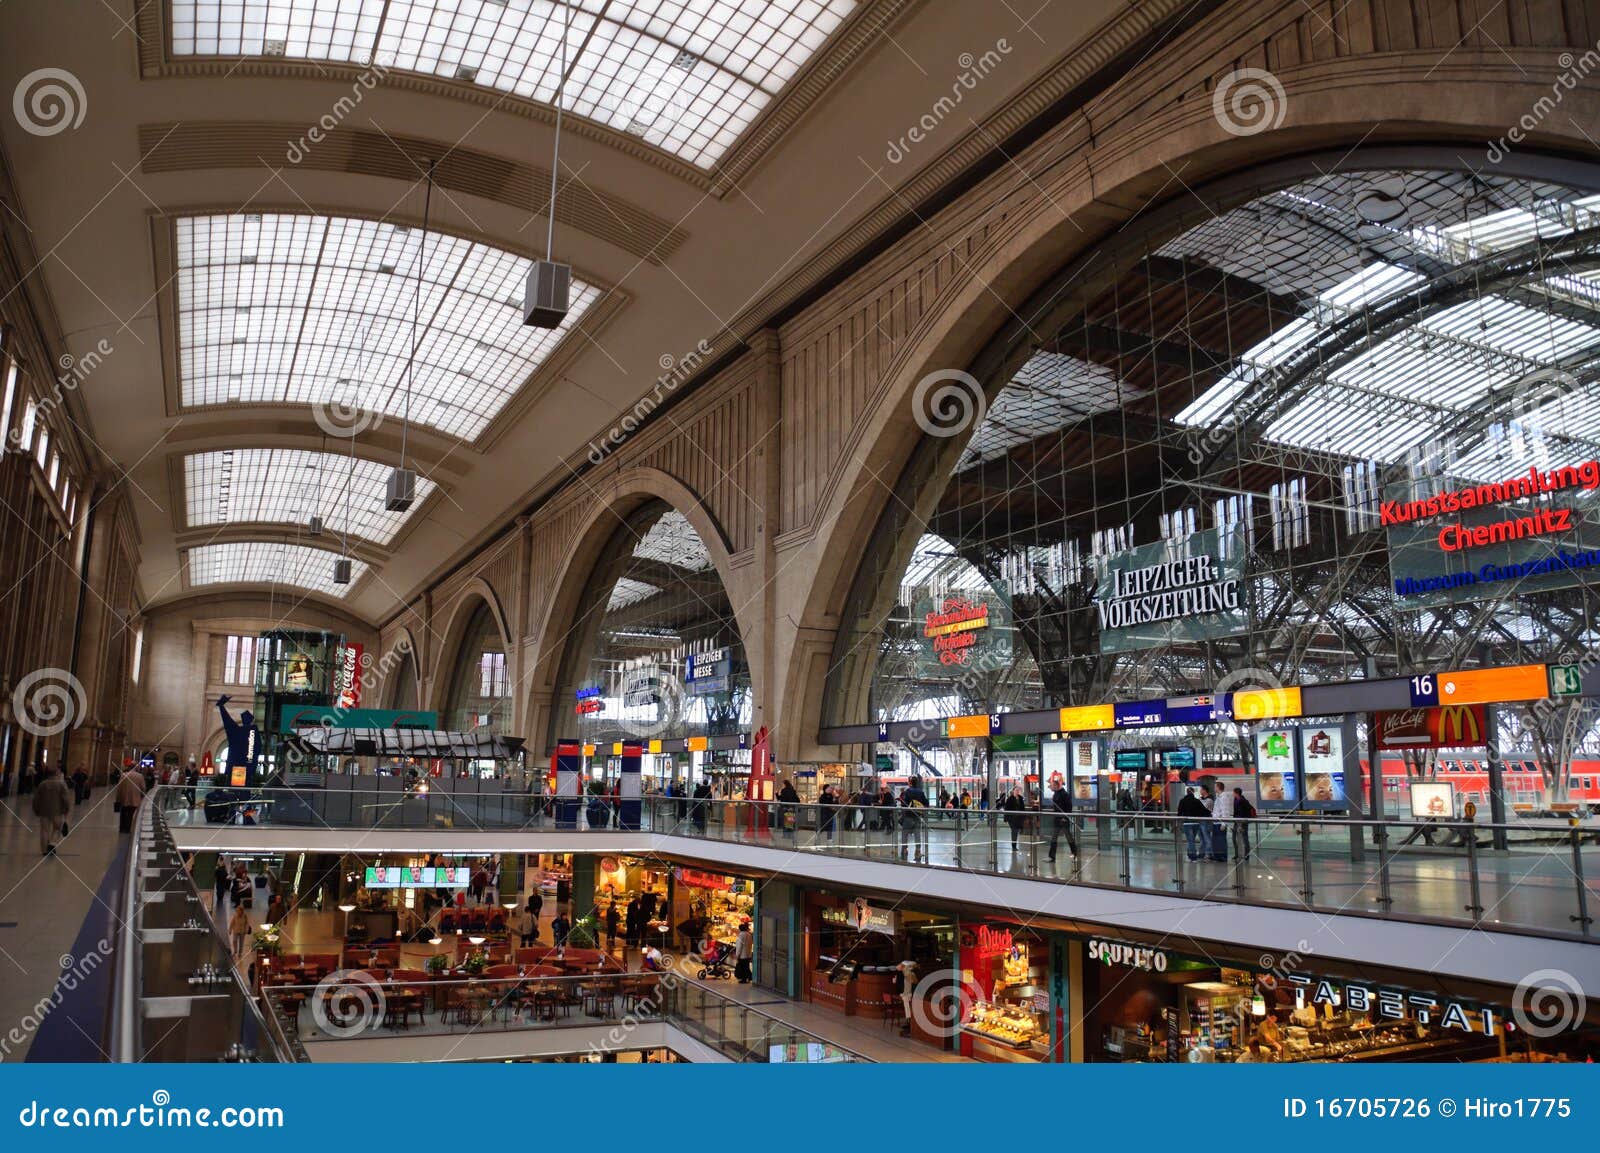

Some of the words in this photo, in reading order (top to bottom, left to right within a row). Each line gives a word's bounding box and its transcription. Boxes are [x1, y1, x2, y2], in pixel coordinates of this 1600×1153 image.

[1379, 460, 1600, 525] Kunstsammlung
[1438, 508, 1572, 551] Chemnitz
[1113, 554, 1211, 599] LEIPZIGER
[1394, 571, 1475, 596] Museum
[1099, 580, 1238, 630] VOLKSZEITUNG
[694, 650, 722, 666] LEIPZIGER
[694, 665, 712, 678] MESSE
[1411, 675, 1433, 695] 16
[879, 724, 887, 735] 14
[990, 715, 1000, 728] 15
[1288, 975, 1494, 1036] TABETAI
